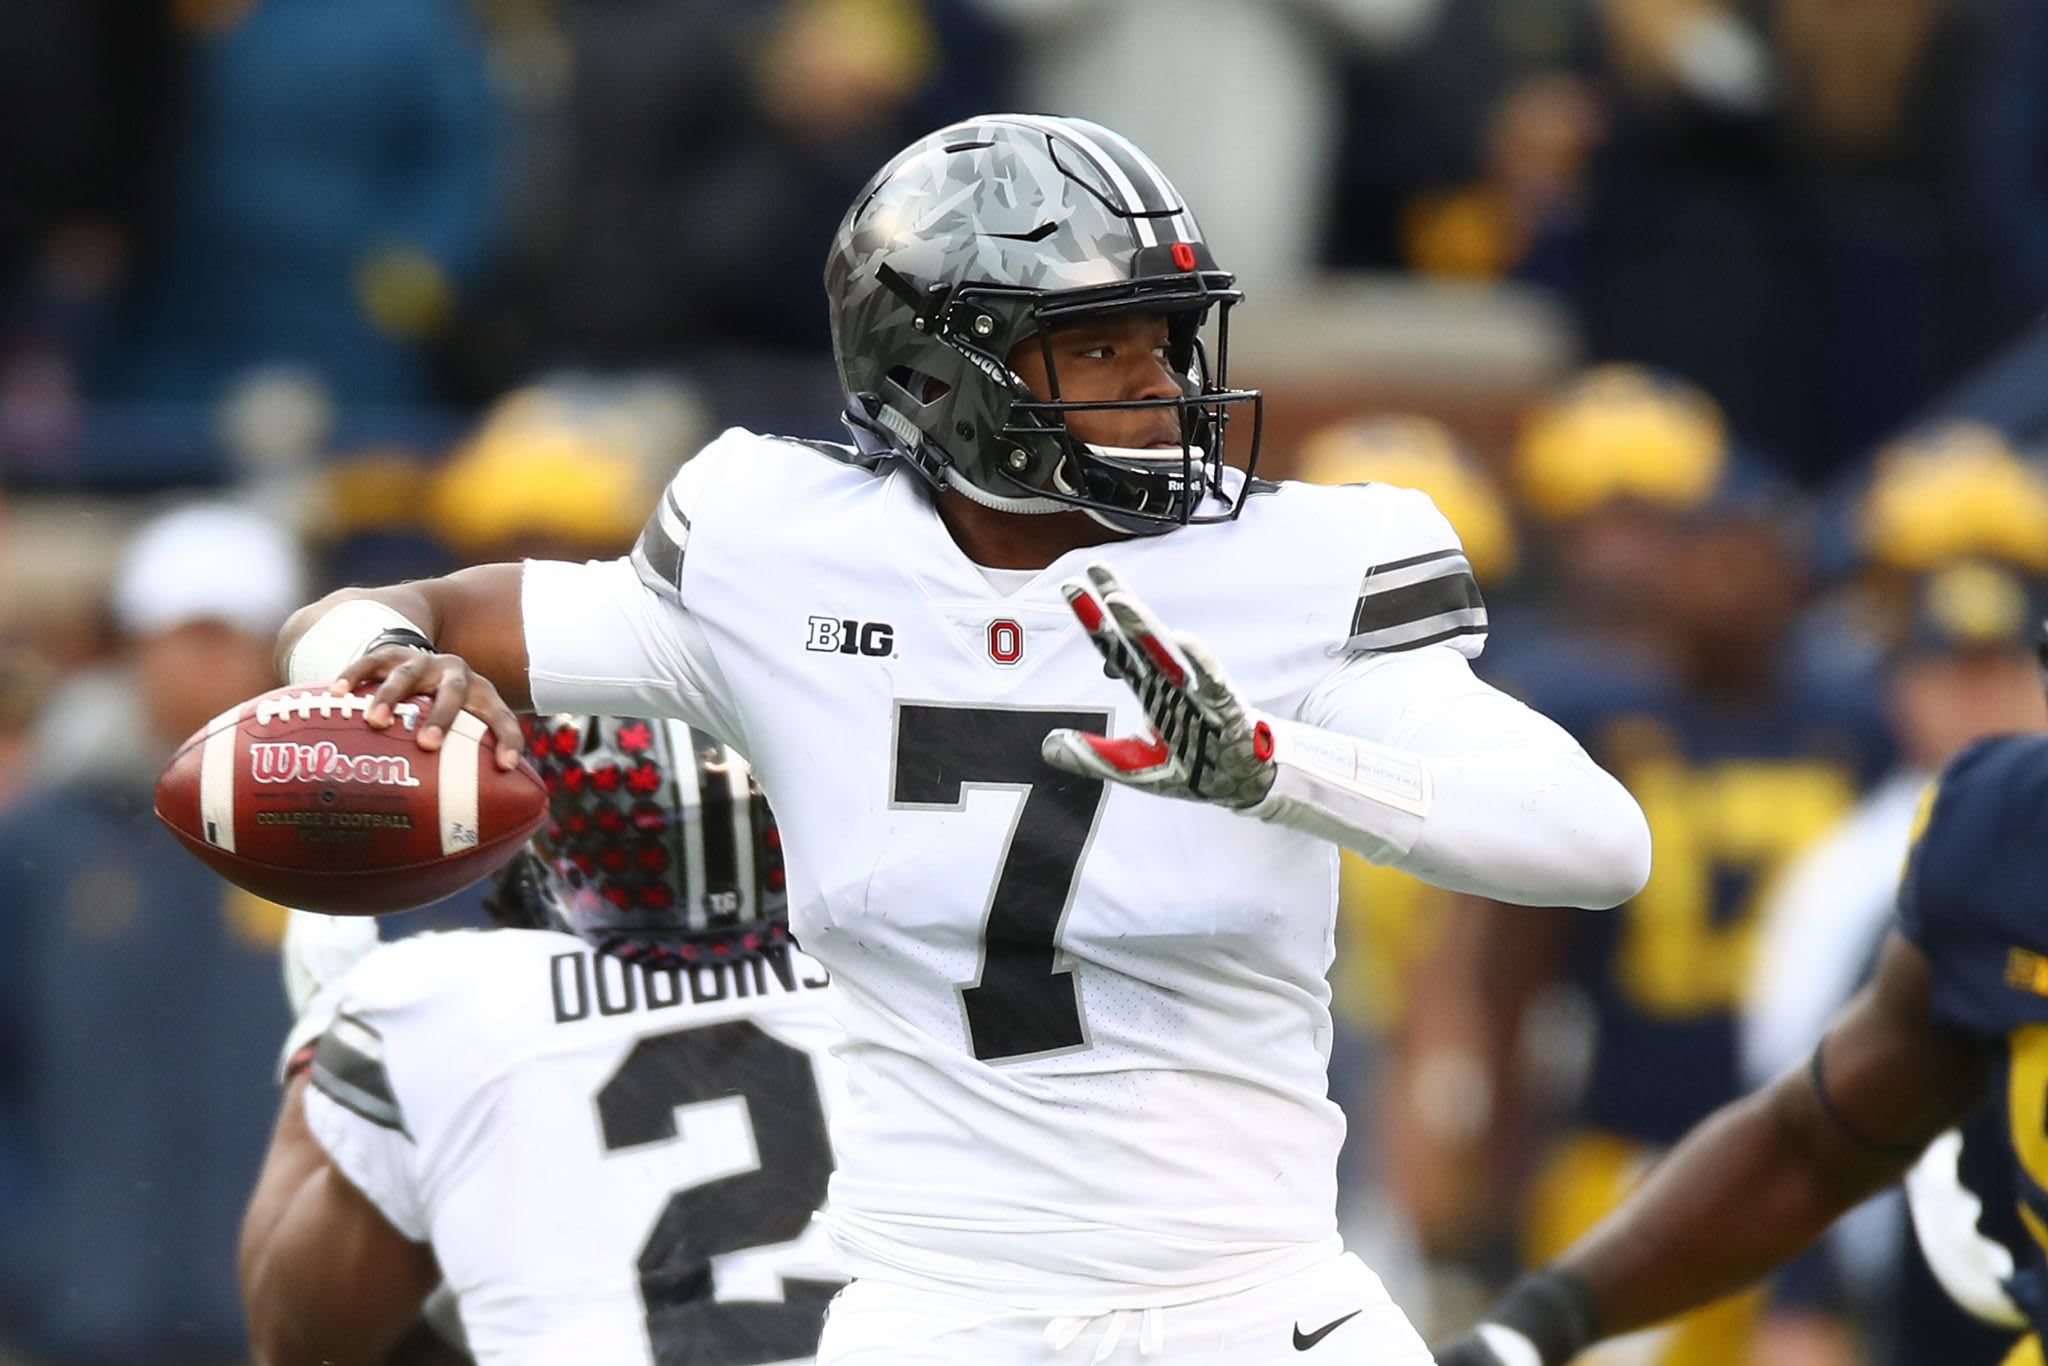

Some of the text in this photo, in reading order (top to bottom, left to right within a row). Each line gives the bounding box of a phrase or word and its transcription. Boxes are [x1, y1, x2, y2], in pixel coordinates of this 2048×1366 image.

[987, 618, 1023, 665] O
[251, 742, 420, 787] Wilson
[257, 812, 412, 829] COLLEGE FOOTBALL
[888, 698, 1116, 1066] 7
[590, 1012, 857, 1366] 2
